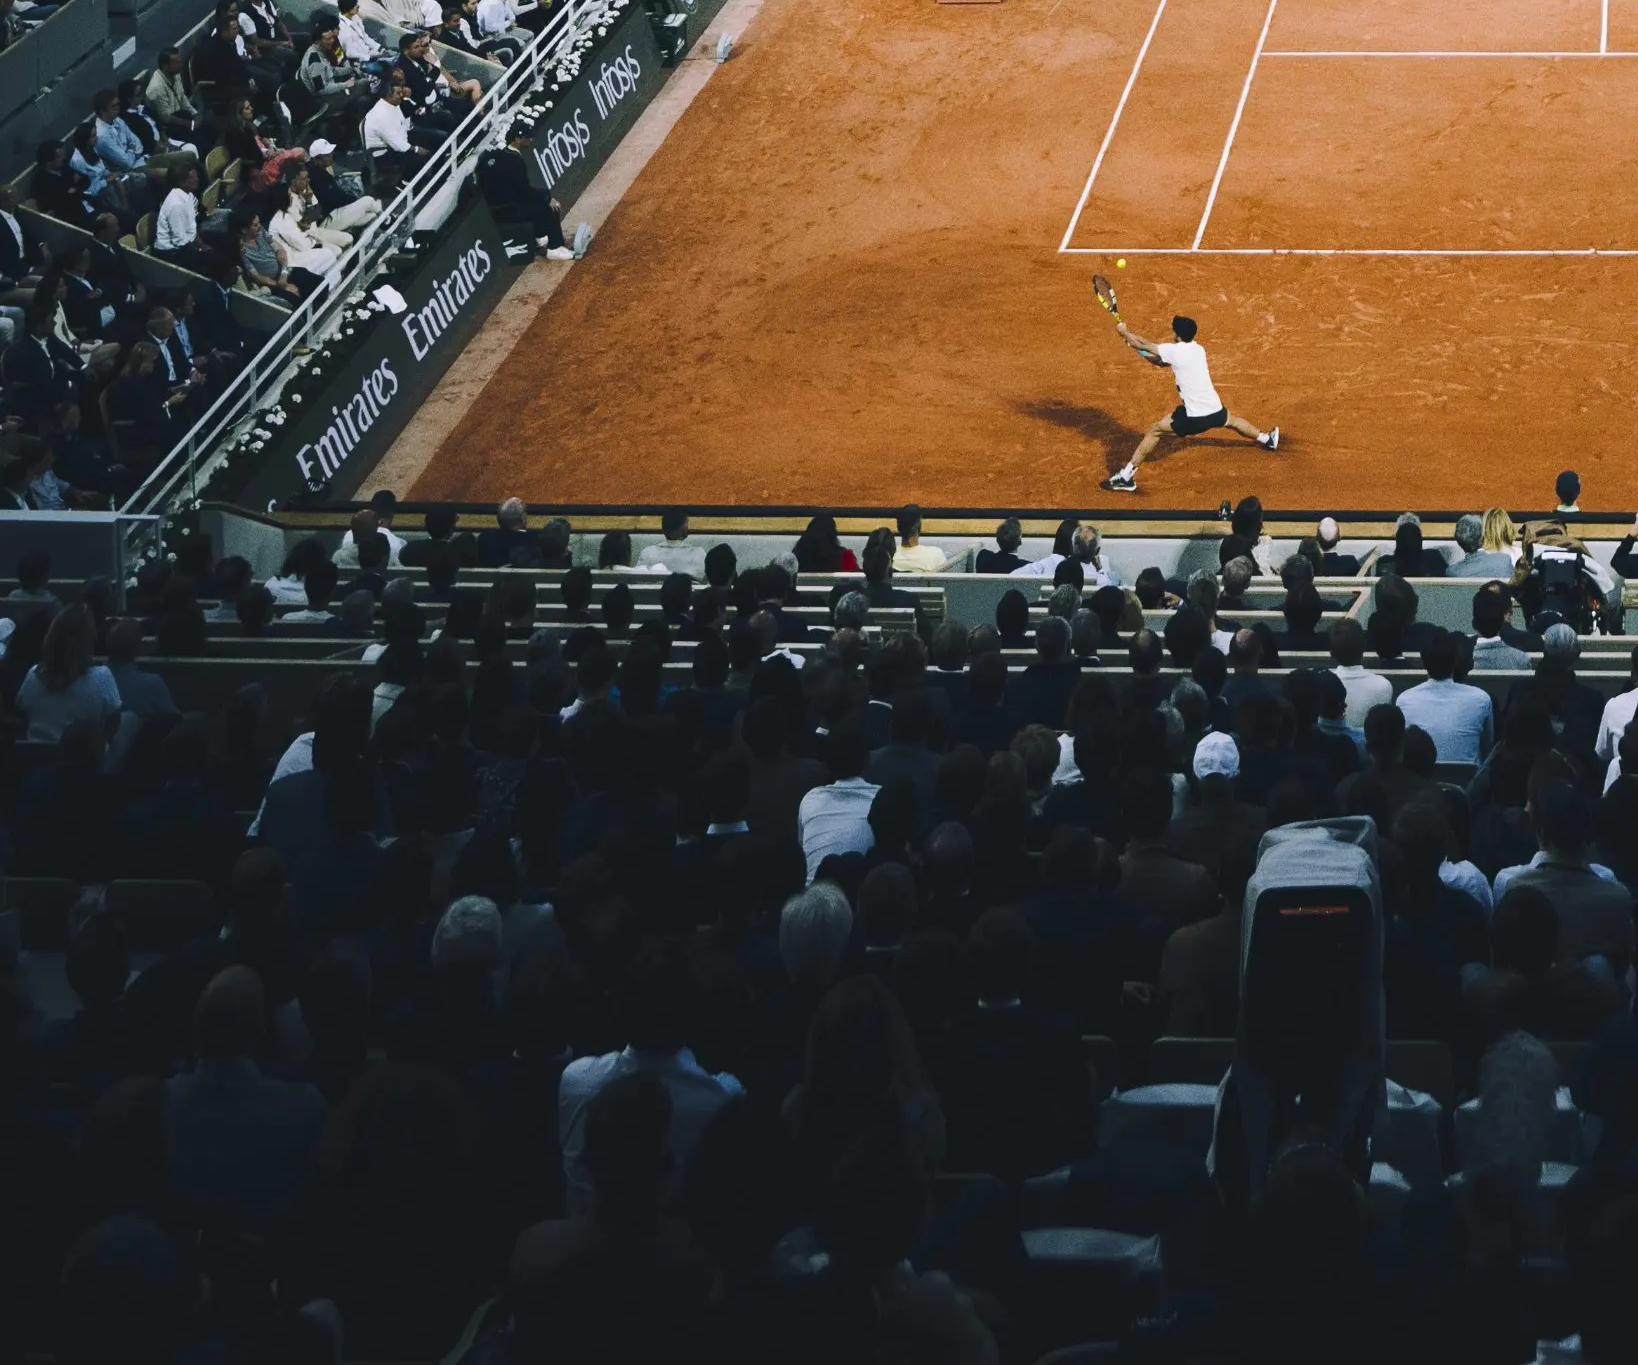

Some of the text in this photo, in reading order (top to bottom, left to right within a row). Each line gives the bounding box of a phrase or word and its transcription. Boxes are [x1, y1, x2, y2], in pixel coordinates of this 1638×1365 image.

[588, 44, 641, 120] Infosys
[533, 108, 591, 190] Infosys
[401, 239, 491, 362] Emirates
